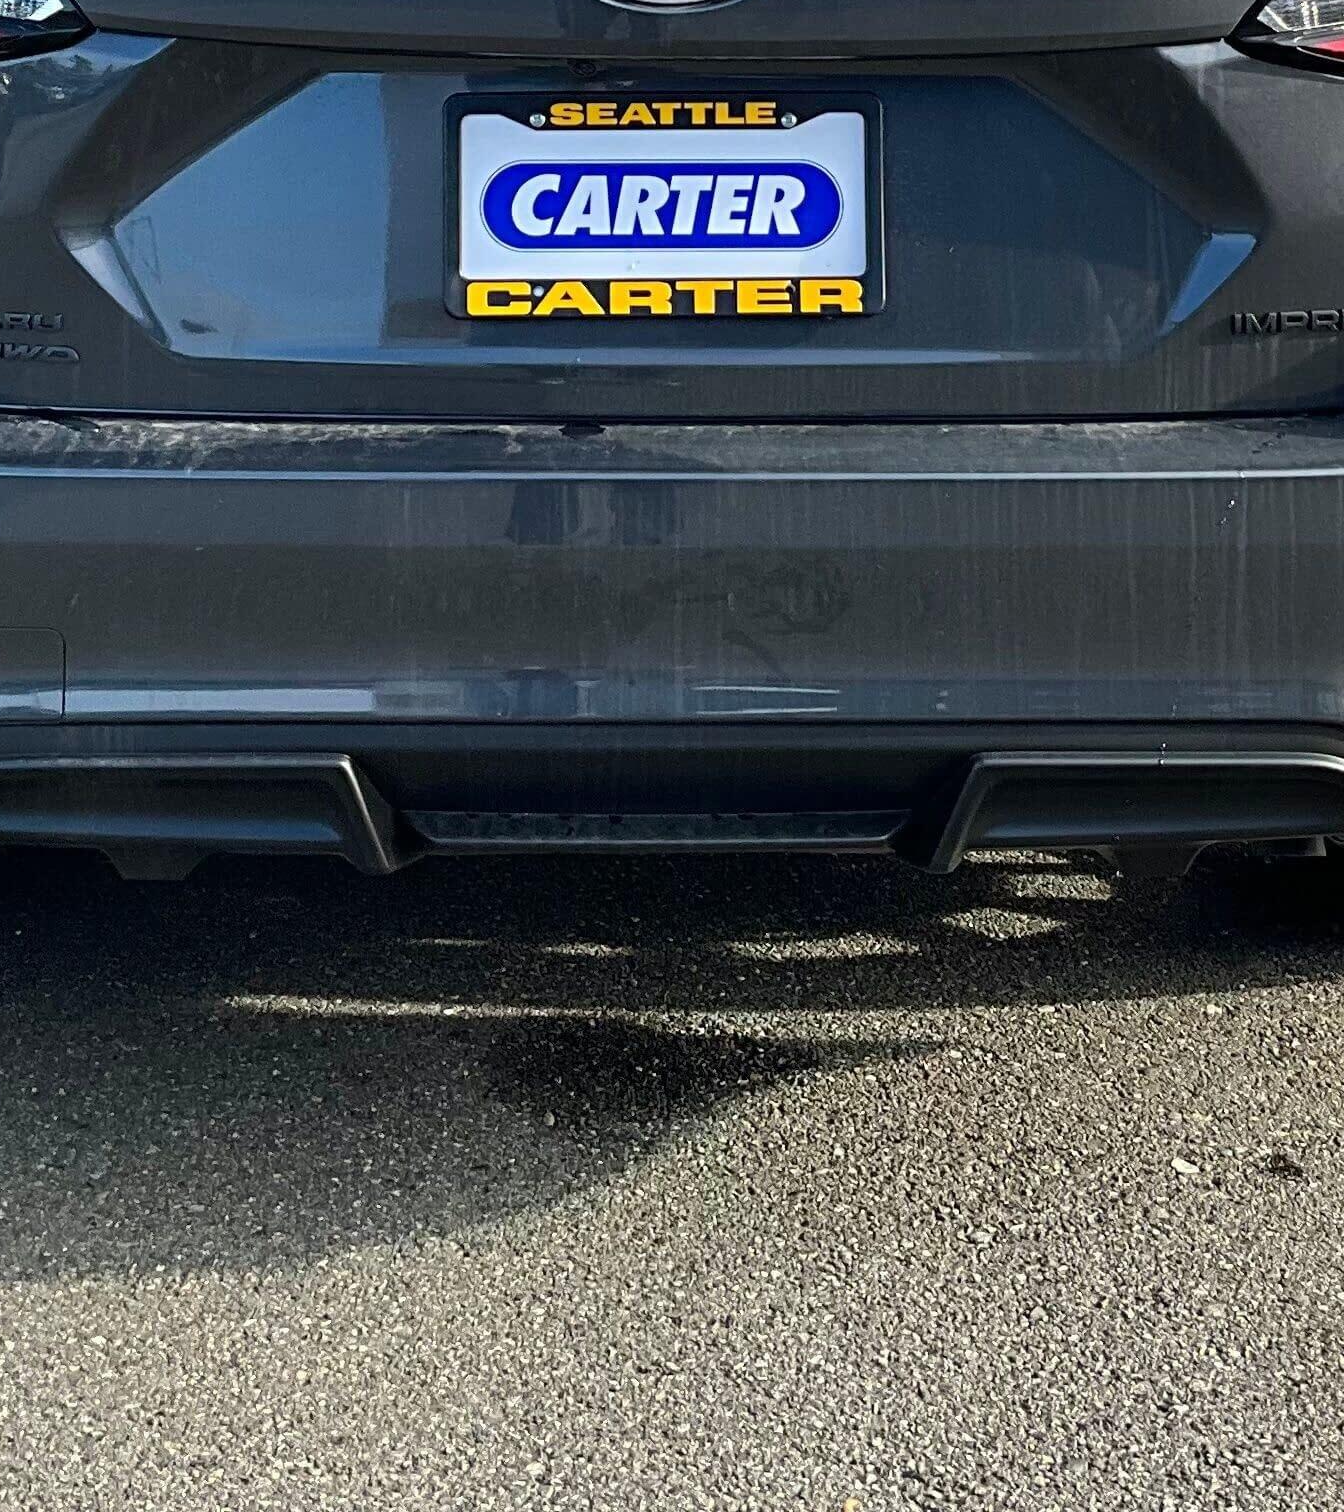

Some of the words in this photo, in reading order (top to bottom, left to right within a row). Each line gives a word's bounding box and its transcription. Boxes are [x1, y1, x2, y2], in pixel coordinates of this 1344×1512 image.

[550, 101, 778, 126] SEATTLE
[510, 173, 807, 236] CARTER
[466, 278, 865, 317] CARTER
